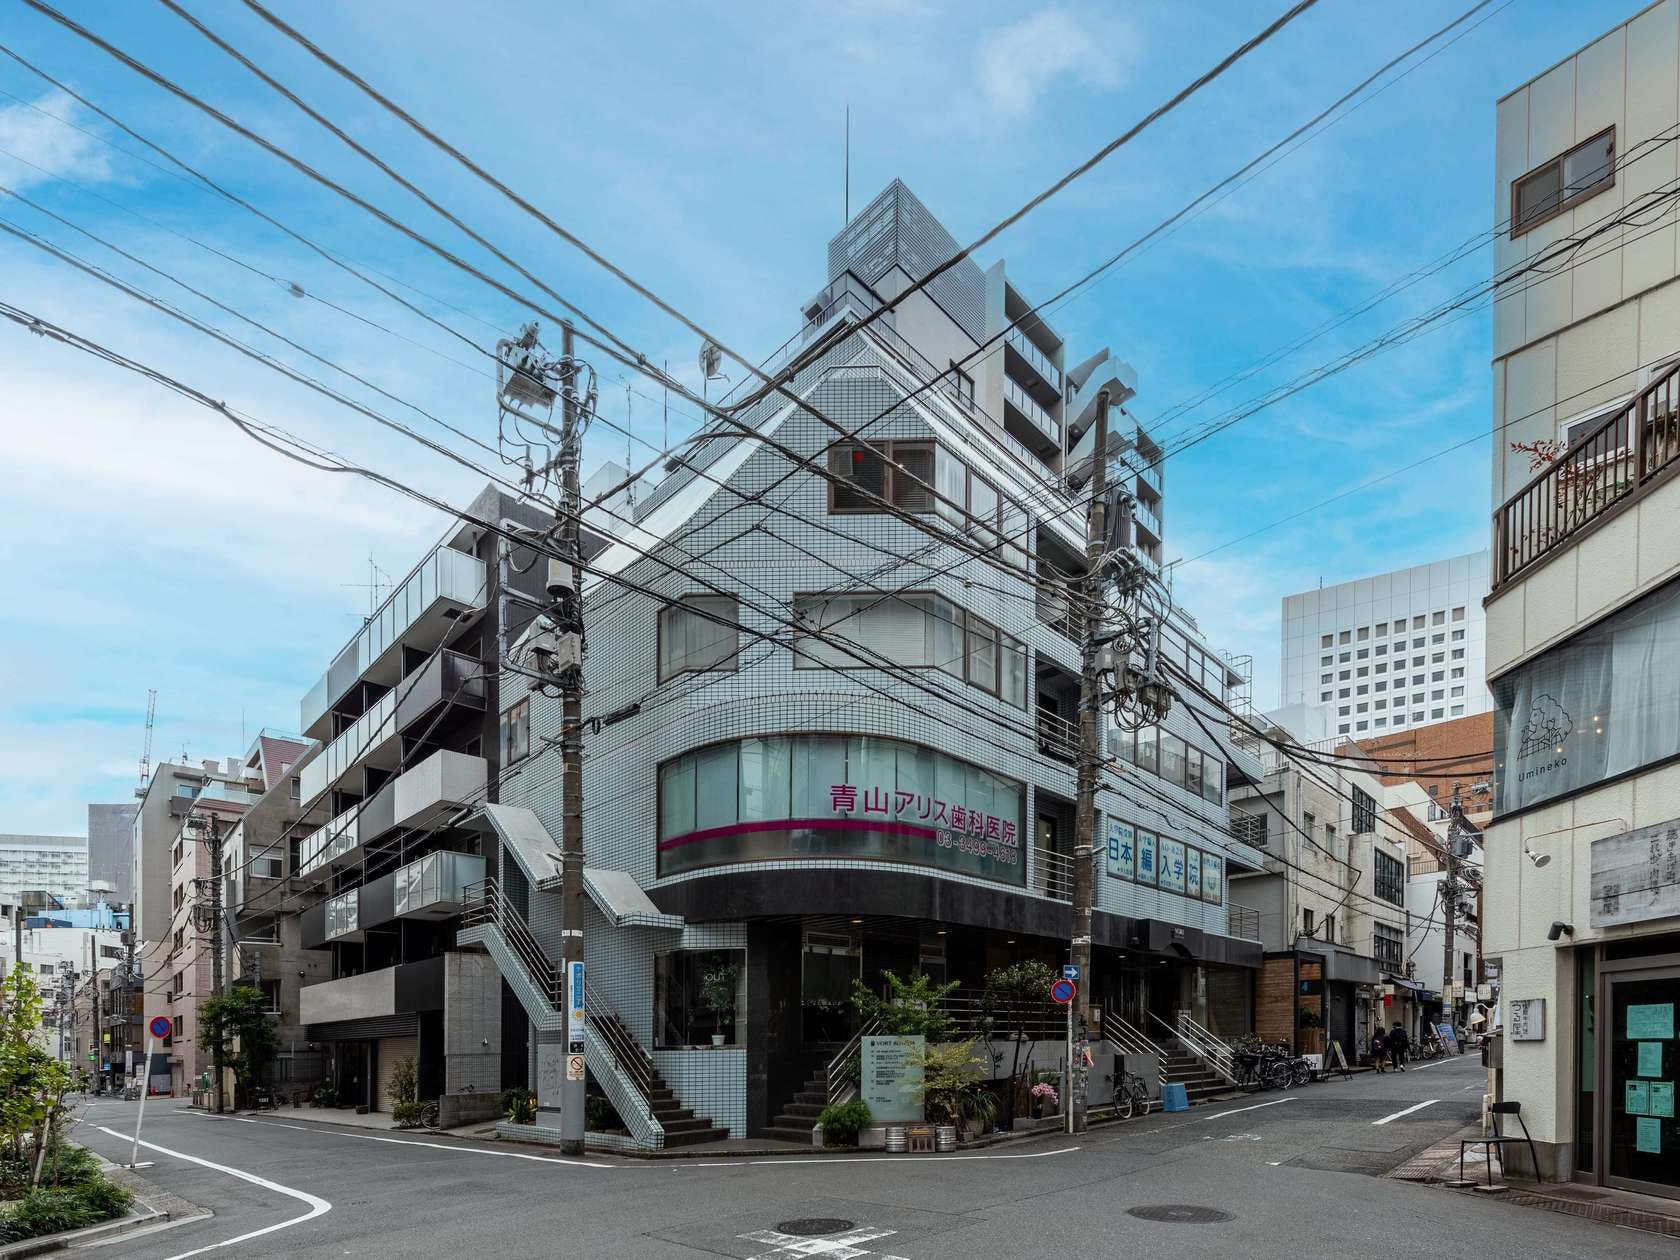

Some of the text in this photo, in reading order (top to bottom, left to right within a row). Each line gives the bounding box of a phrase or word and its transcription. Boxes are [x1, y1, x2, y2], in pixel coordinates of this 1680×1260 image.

[1518, 758, 1567, 782] Umineko
[830, 784, 1016, 847] 青山アリス歯科医院
